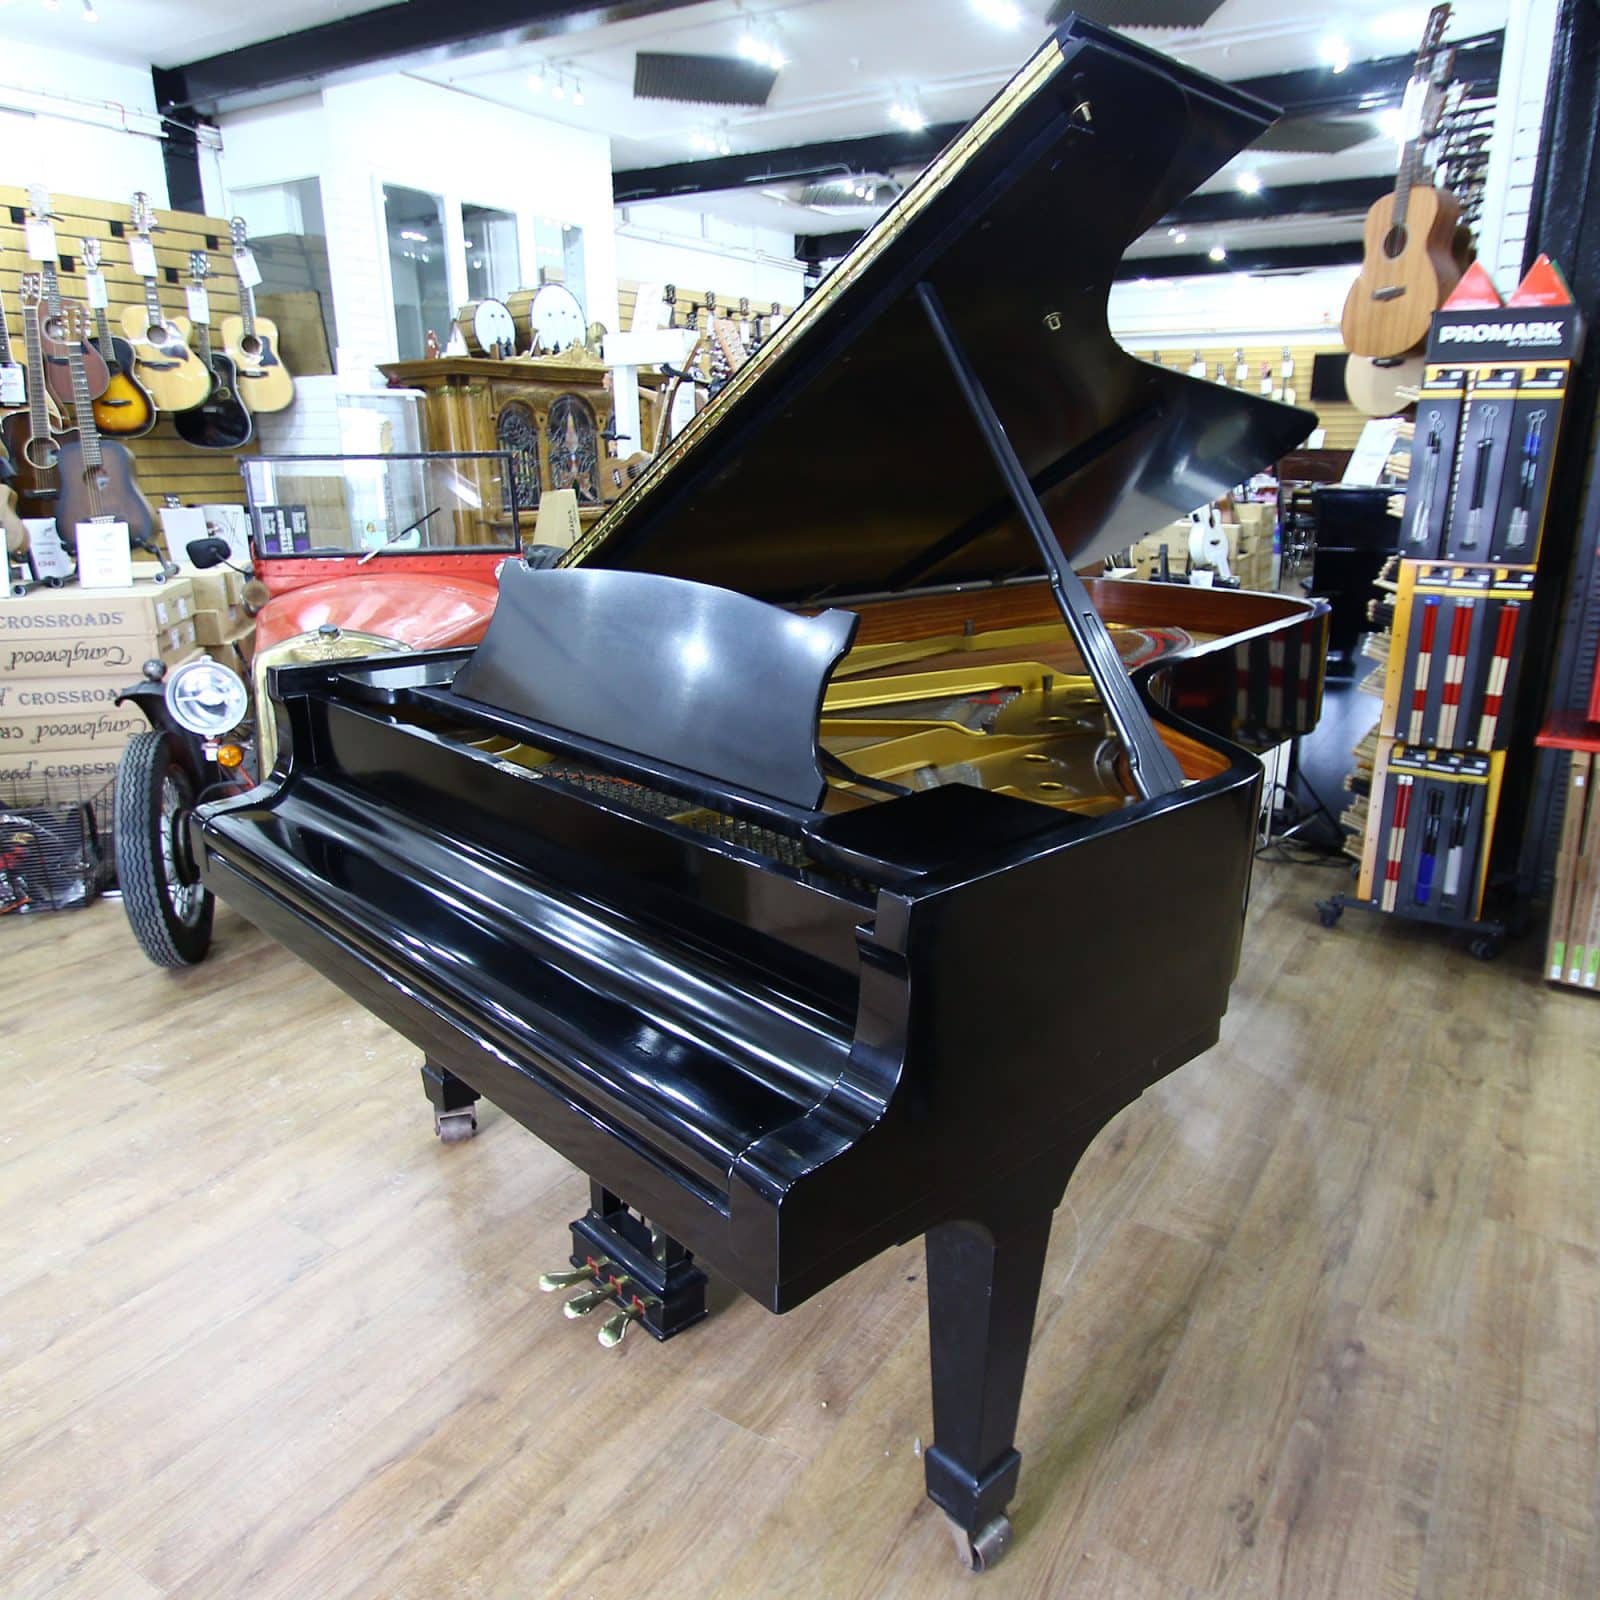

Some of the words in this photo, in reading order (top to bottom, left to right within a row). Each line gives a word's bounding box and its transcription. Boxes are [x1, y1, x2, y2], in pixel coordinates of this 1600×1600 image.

[1439, 321, 1564, 344] PROMARK
[0, 612, 123, 629] CROSSROADS
[11, 642, 132, 670] Tanglewood
[18, 689, 119, 706] CROSSROA
[45, 762, 117, 778] CROSSR
